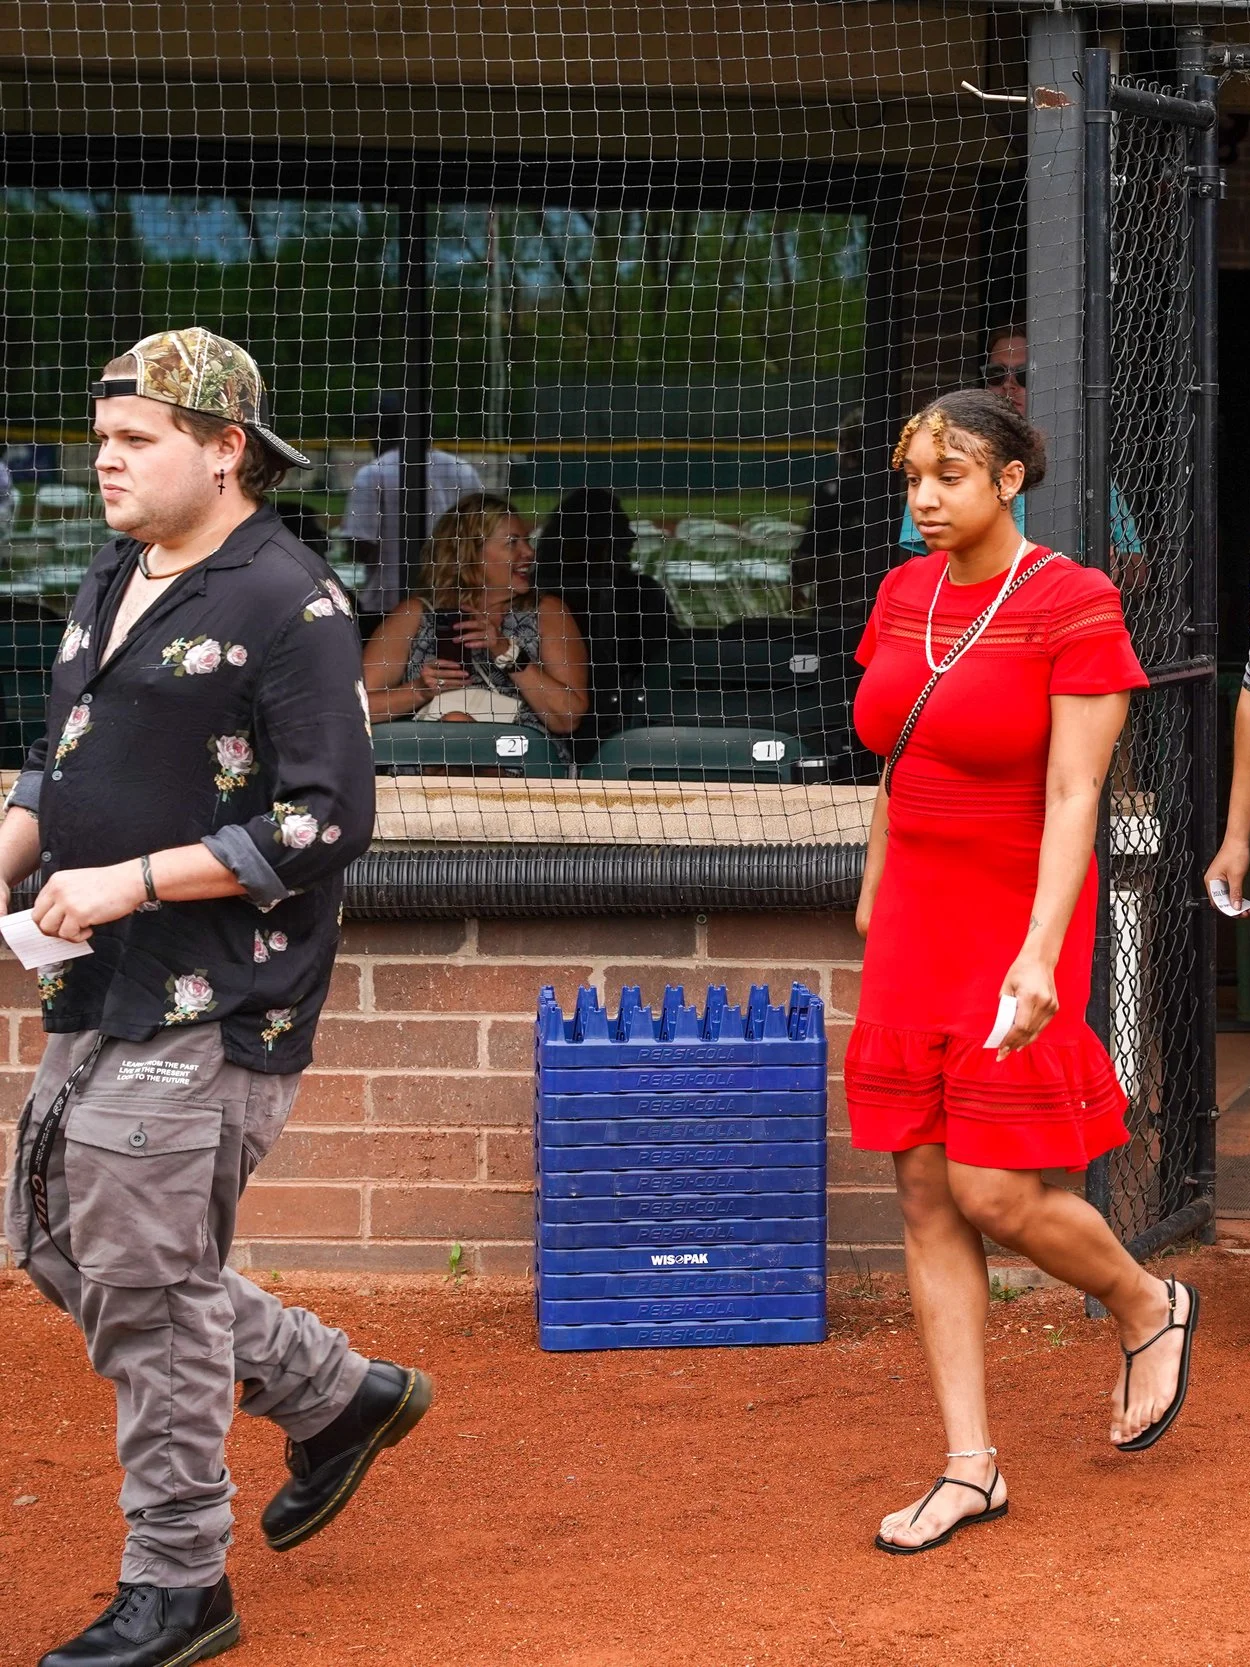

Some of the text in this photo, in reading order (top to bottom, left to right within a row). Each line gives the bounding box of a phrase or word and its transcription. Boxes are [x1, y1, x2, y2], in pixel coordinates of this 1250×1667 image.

[507, 738, 516, 754] 2
[766, 743, 771, 758] 1
[118, 1066, 135, 1074] LIVE
[156, 1068, 191, 1077] PRESENT
[164, 1061, 179, 1069] THE
[179, 1063, 200, 1071] PAST
[146, 1074, 161, 1082] THE
[161, 1076, 191, 1085] FUTURE
